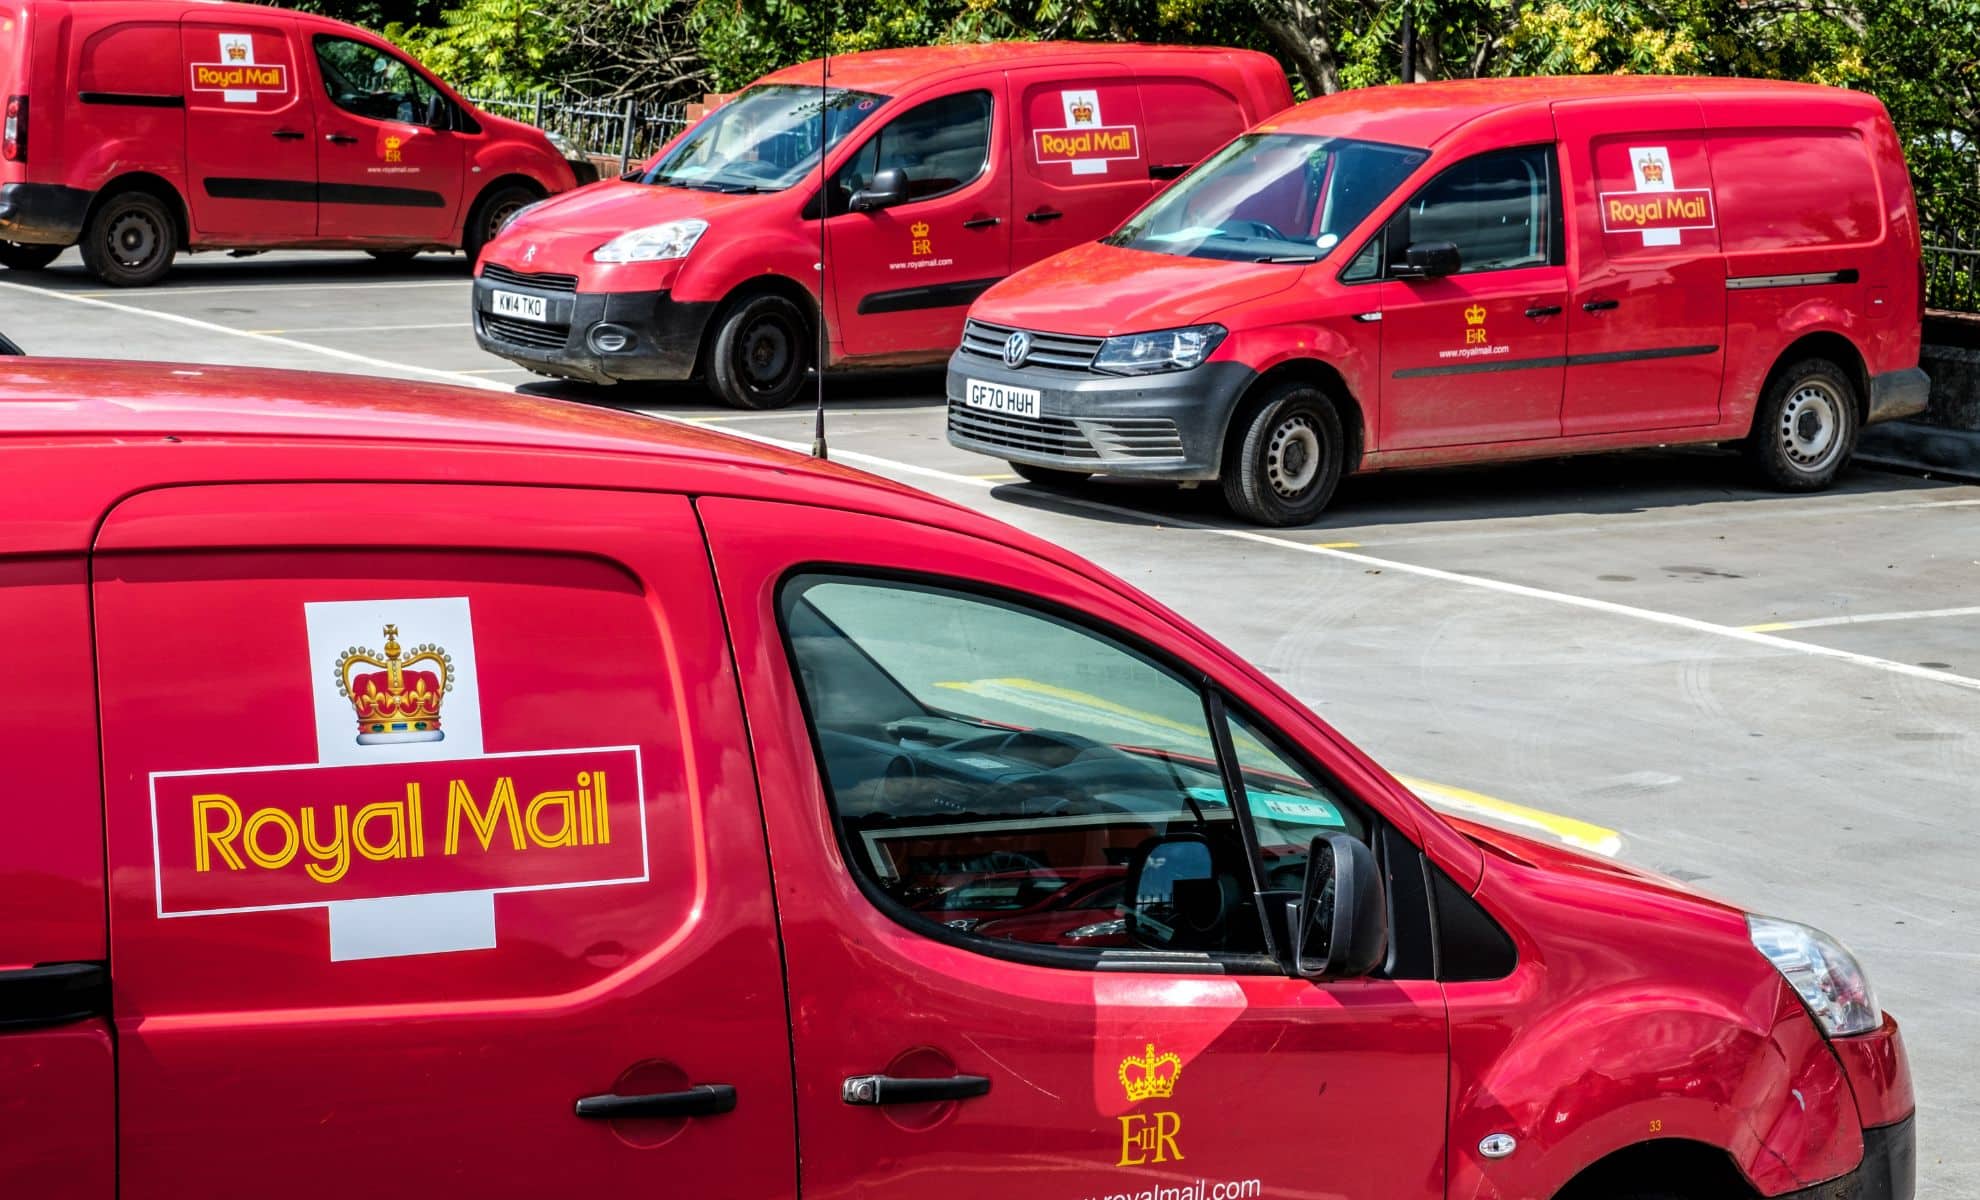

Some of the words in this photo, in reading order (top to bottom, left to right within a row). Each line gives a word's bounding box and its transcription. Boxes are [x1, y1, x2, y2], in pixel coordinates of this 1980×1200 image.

[198, 67, 243, 87] Royal
[245, 68, 279, 85] Mail
[1042, 132, 1091, 157] Royal
[1094, 131, 1130, 151] Mail
[1610, 199, 1663, 225] Royal
[1666, 197, 1706, 219] Mail
[500, 295, 519, 312] KW14
[1439, 344, 1509, 359] www.royalmail.com
[972, 384, 1004, 409] GF70
[1007, 391, 1034, 415] HUH
[192, 782, 425, 884] Royal
[444, 771, 611, 856] Mail
[1649, 1119, 1661, 1132] 33
